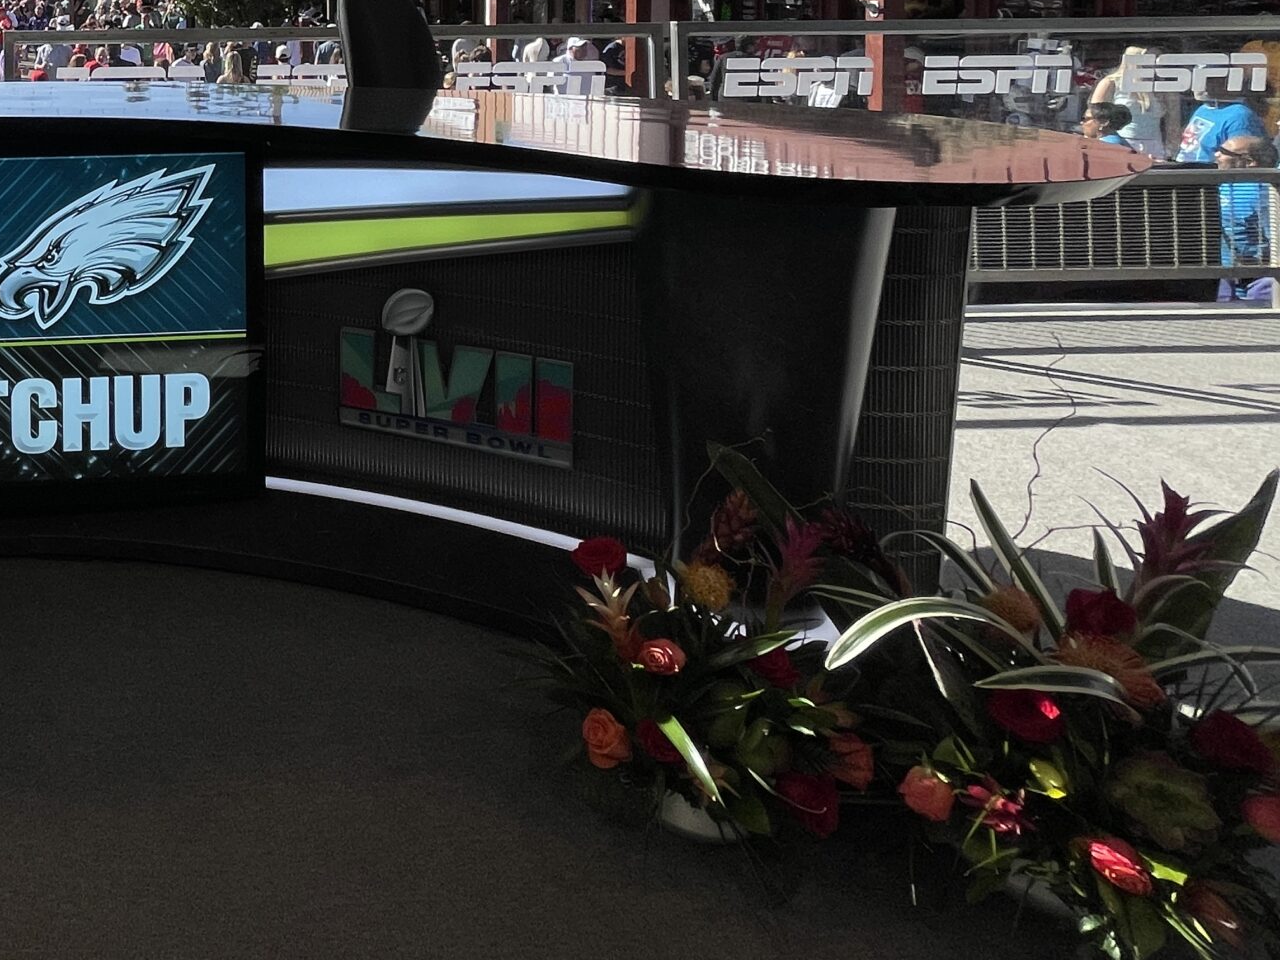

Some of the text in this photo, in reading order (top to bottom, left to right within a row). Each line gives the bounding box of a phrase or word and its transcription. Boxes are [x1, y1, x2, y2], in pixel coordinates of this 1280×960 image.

[723, 56, 874, 97] ESPN
[921, 54, 1072, 95] ESPN
[1121, 52, 1268, 92] ESPN
[358, 412, 552, 458] SUPER BOWL
